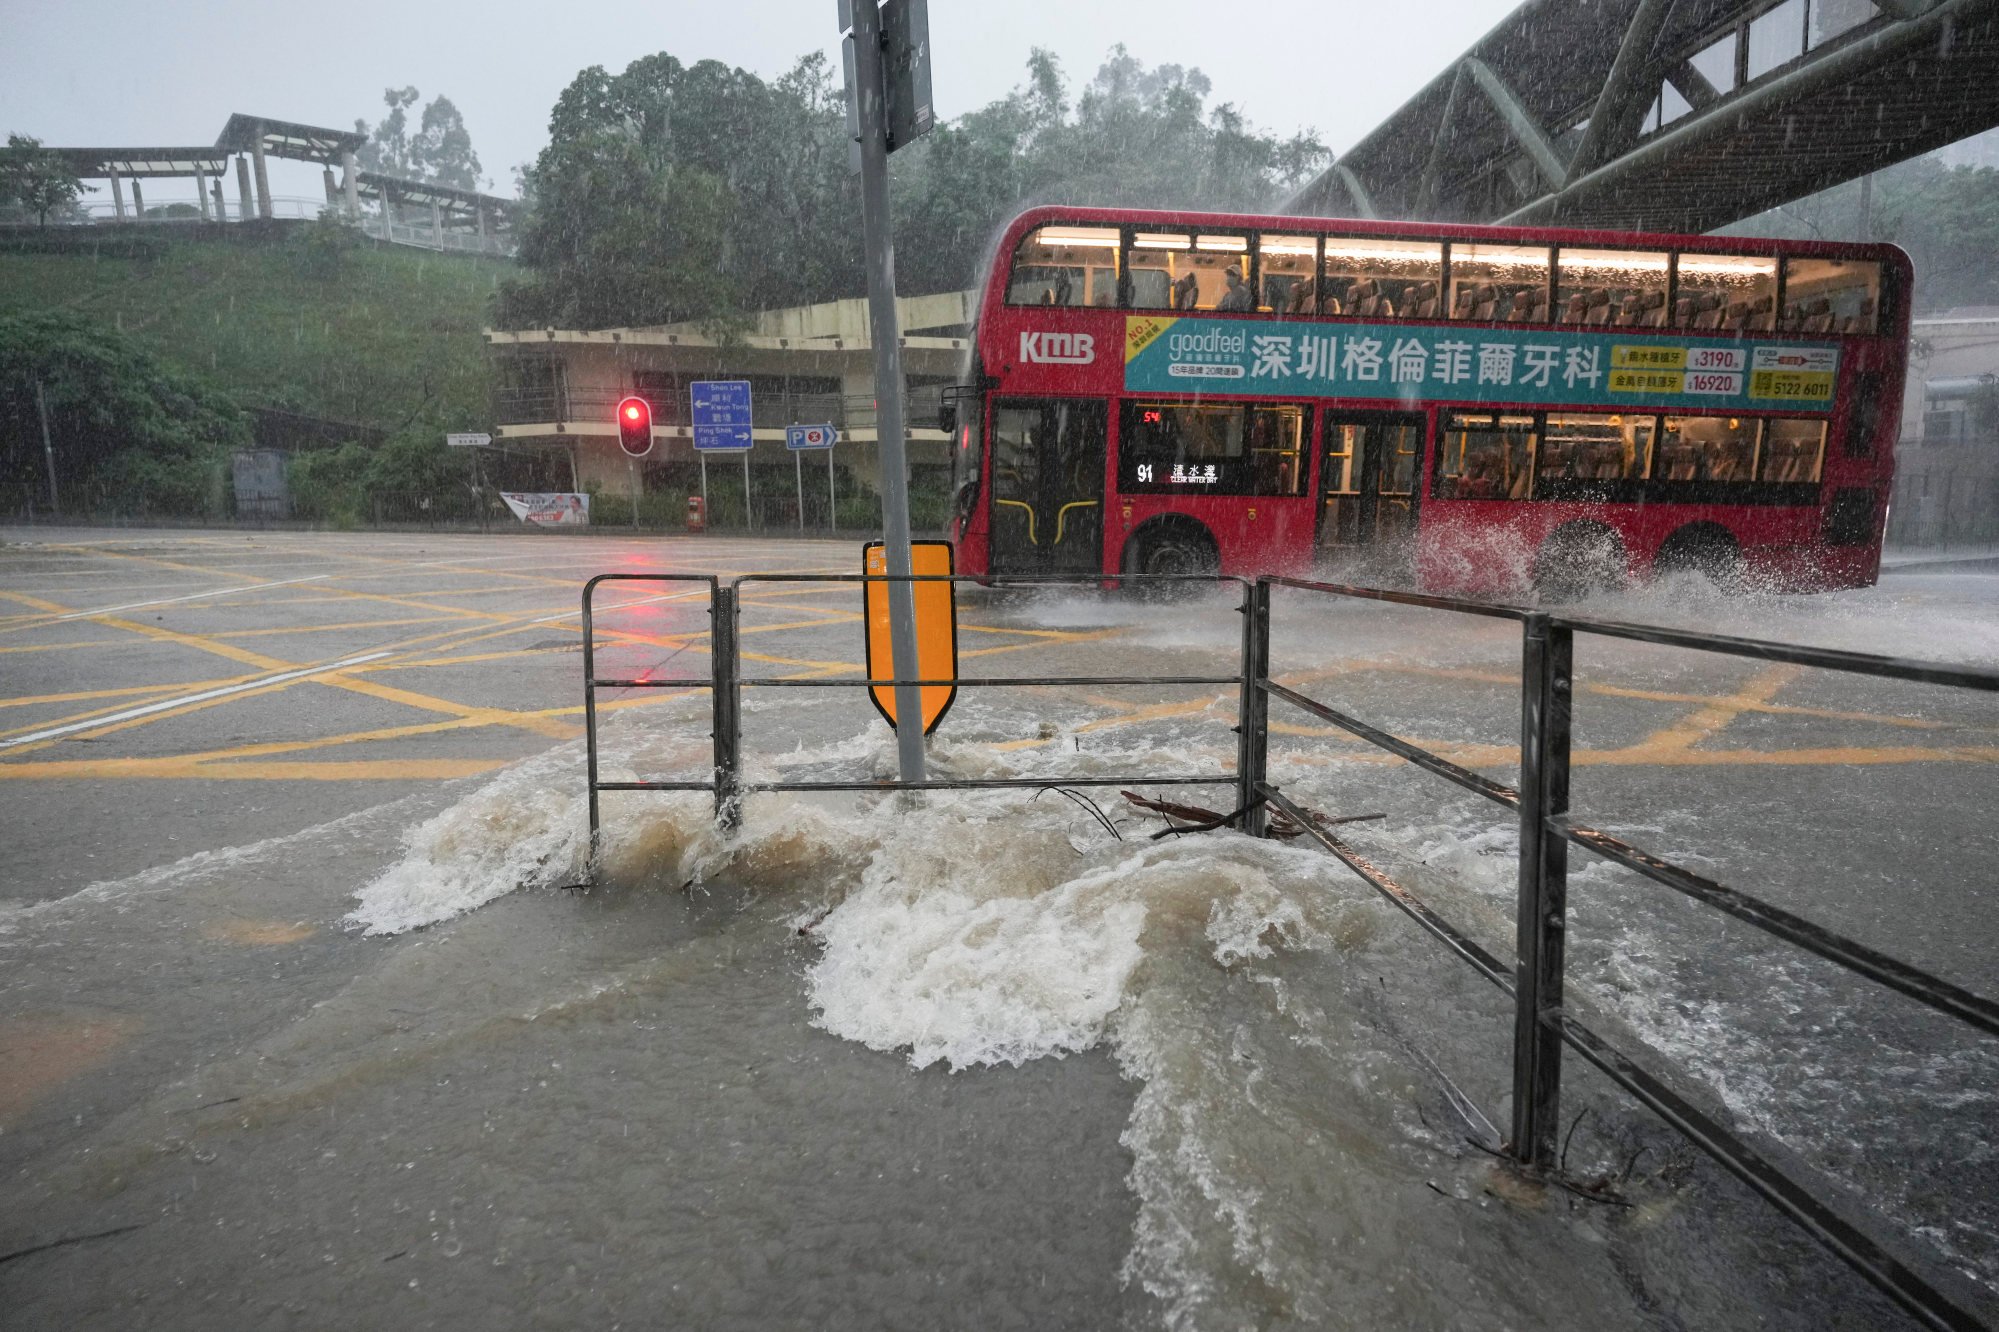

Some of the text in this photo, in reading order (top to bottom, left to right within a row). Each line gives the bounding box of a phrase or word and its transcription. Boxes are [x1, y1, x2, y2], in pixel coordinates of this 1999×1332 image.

[1169, 327, 1245, 361] goodfeel
[1250, 334, 1602, 389] 深圳格倫菲爾牙科
[1774, 383, 1829, 396] 5122 6011
[1137, 464, 1153, 482] 91
